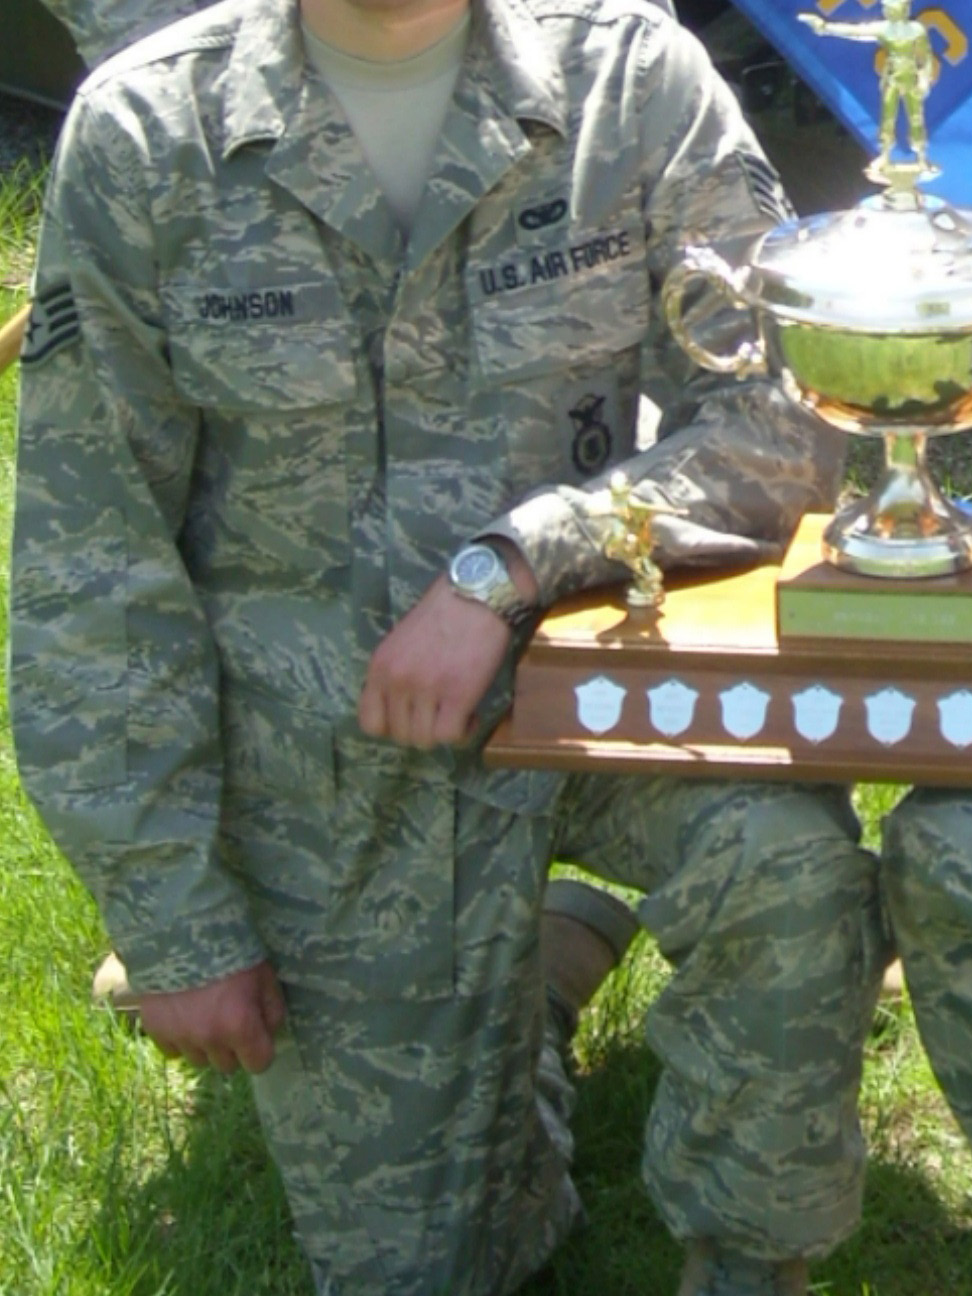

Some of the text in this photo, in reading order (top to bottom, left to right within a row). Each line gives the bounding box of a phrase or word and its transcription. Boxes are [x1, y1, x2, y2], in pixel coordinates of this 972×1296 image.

[479, 231, 631, 295] U.S. AIR FORCE
[199, 290, 295, 321] JOHNSON
